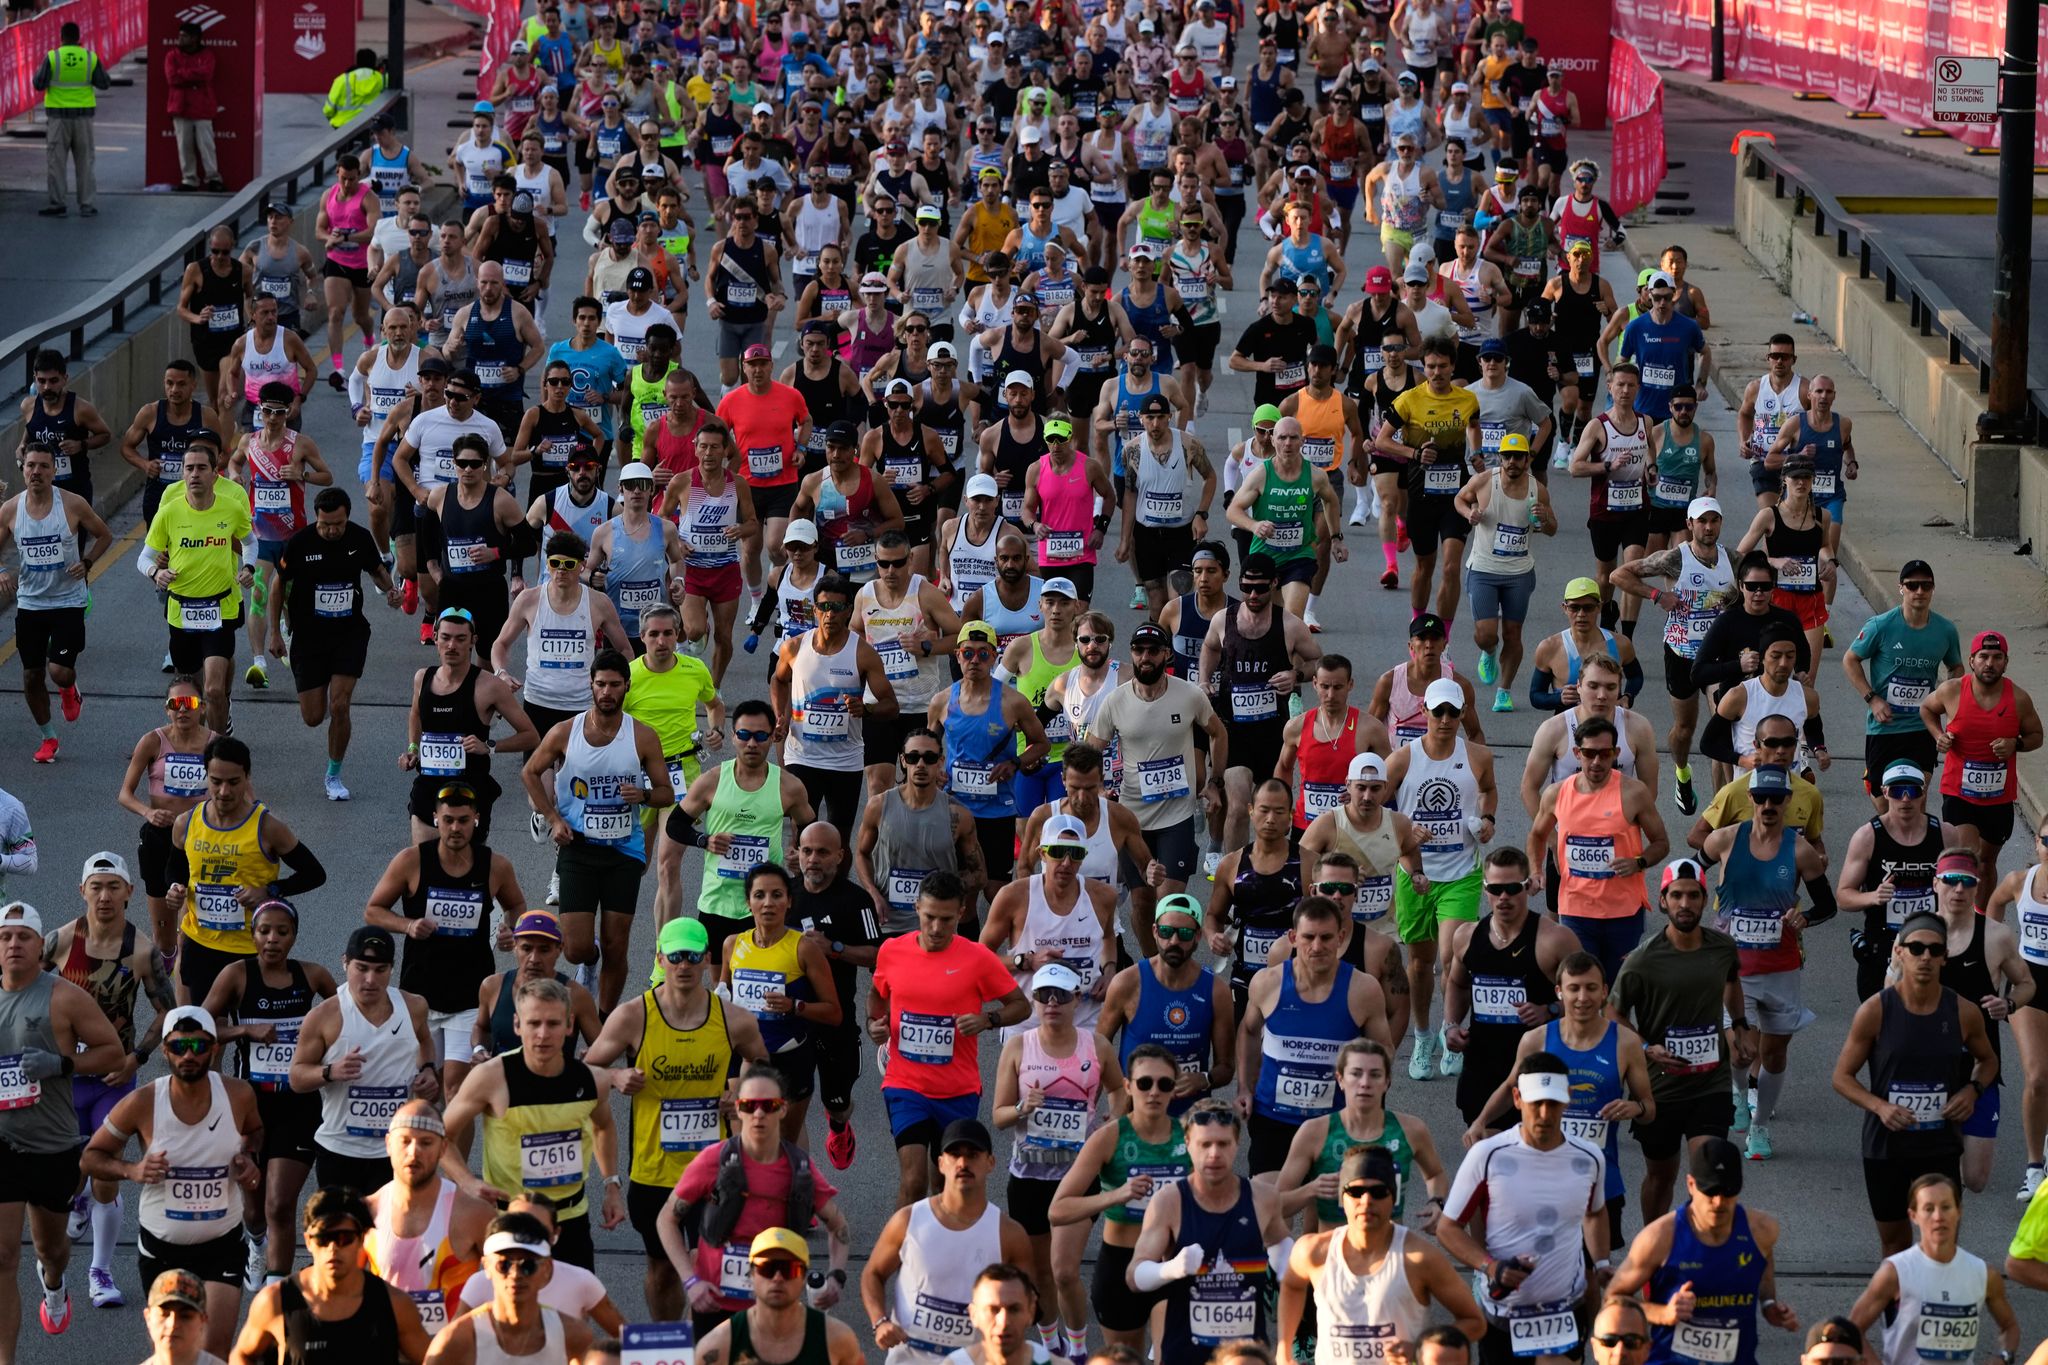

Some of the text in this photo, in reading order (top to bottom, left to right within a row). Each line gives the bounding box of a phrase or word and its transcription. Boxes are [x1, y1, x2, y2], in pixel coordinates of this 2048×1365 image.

[1547, 58, 1598, 71] ABBOTT
[1938, 113, 1992, 121] TOW ZONE
[505, 268, 528, 278] C7643
[264, 283, 288, 292] C8095
[729, 288, 755, 297] C15647
[916, 295, 940, 303] C8725
[1046, 291, 1072, 300] B18264
[825, 302, 848, 310] C8742
[212, 312, 235, 321] C5647
[1644, 368, 1673, 379] C15666
[1484, 430, 1505, 440] 6628
[1302, 447, 1333, 457] C17646
[752, 455, 779, 466] C1748
[164, 462, 181, 472] C27
[894, 466, 917, 476] 2743
[1430, 471, 1457, 482] C1795
[1814, 477, 1831, 487] 773
[1269, 488, 1309, 496] FINTAN
[1612, 488, 1638, 499] C8705
[1660, 483, 1687, 494] C6630
[258, 491, 286, 501] C7682
[698, 505, 729, 515] TEAM
[1006, 501, 1022, 510] C47
[1147, 501, 1181, 511] C17779
[698, 514, 722, 524] USA
[180, 537, 227, 549] RunFun
[691, 535, 727, 546] C16698
[1051, 540, 1080, 551] D3440
[1500, 534, 1526, 546] C1640
[27, 545, 58, 557] C2696
[449, 548, 470, 559] C19
[841, 546, 871, 557] C6695
[953, 557, 995, 566] SKECHERS
[1782, 566, 1812, 577] C99
[320, 592, 349, 603] C7751
[622, 589, 658, 602] C13607
[186, 610, 216, 621] C2680
[542, 641, 584, 653] C11715
[881, 652, 910, 665] 7734
[1893, 687, 1925, 698] C6627
[1234, 693, 1274, 708] C20753
[808, 714, 844, 726] C2772
[422, 746, 463, 759] C13601
[590, 775, 637, 786] BREATHE
[1145, 769, 1181, 785] C4738
[1968, 772, 2001, 784] C8112
[592, 786, 621, 799] TEA
[1416, 777, 1433, 797] TIMBER
[1435, 777, 1460, 793] RUNNING
[1309, 793, 1338, 807] C678
[586, 816, 630, 829] C18712
[194, 840, 241, 856] BRASIL
[1571, 848, 1608, 861] C8666
[896, 881, 920, 893] C87
[1362, 889, 1390, 903] 5753
[199, 897, 238, 912] C2649
[1893, 901, 1931, 914] C1745
[433, 903, 475, 919] C8693
[1738, 921, 1776, 933] C1714
[2025, 925, 2047, 940] C15
[1246, 939, 1268, 954] C16
[1475, 990, 1524, 1005] C18780
[901, 1025, 952, 1045] C21766
[1282, 1039, 1339, 1052] HORSFORTH
[1668, 1038, 1716, 1054] B19321
[256, 1047, 293, 1062] C769
[652, 1054, 719, 1081] Somerville
[1, 1070, 37, 1087] 638
[1285, 1081, 1328, 1097] C8147
[1896, 1095, 1940, 1111] C2724
[664, 1112, 717, 1128] C17783
[1034, 1113, 1080, 1130] C4785
[1562, 1120, 1605, 1138] 13757
[529, 1145, 576, 1167] C7616
[173, 1182, 222, 1199] C8105
[1195, 1274, 1245, 1282] SAN DIEGO
[1193, 1304, 1253, 1322] C16644
[913, 1308, 973, 1336] E18955
[1513, 1316, 1575, 1340] C21779
[1922, 1320, 1977, 1337] C19620
[1682, 1328, 1732, 1349] C5617
[1332, 1342, 1384, 1359] B1538
